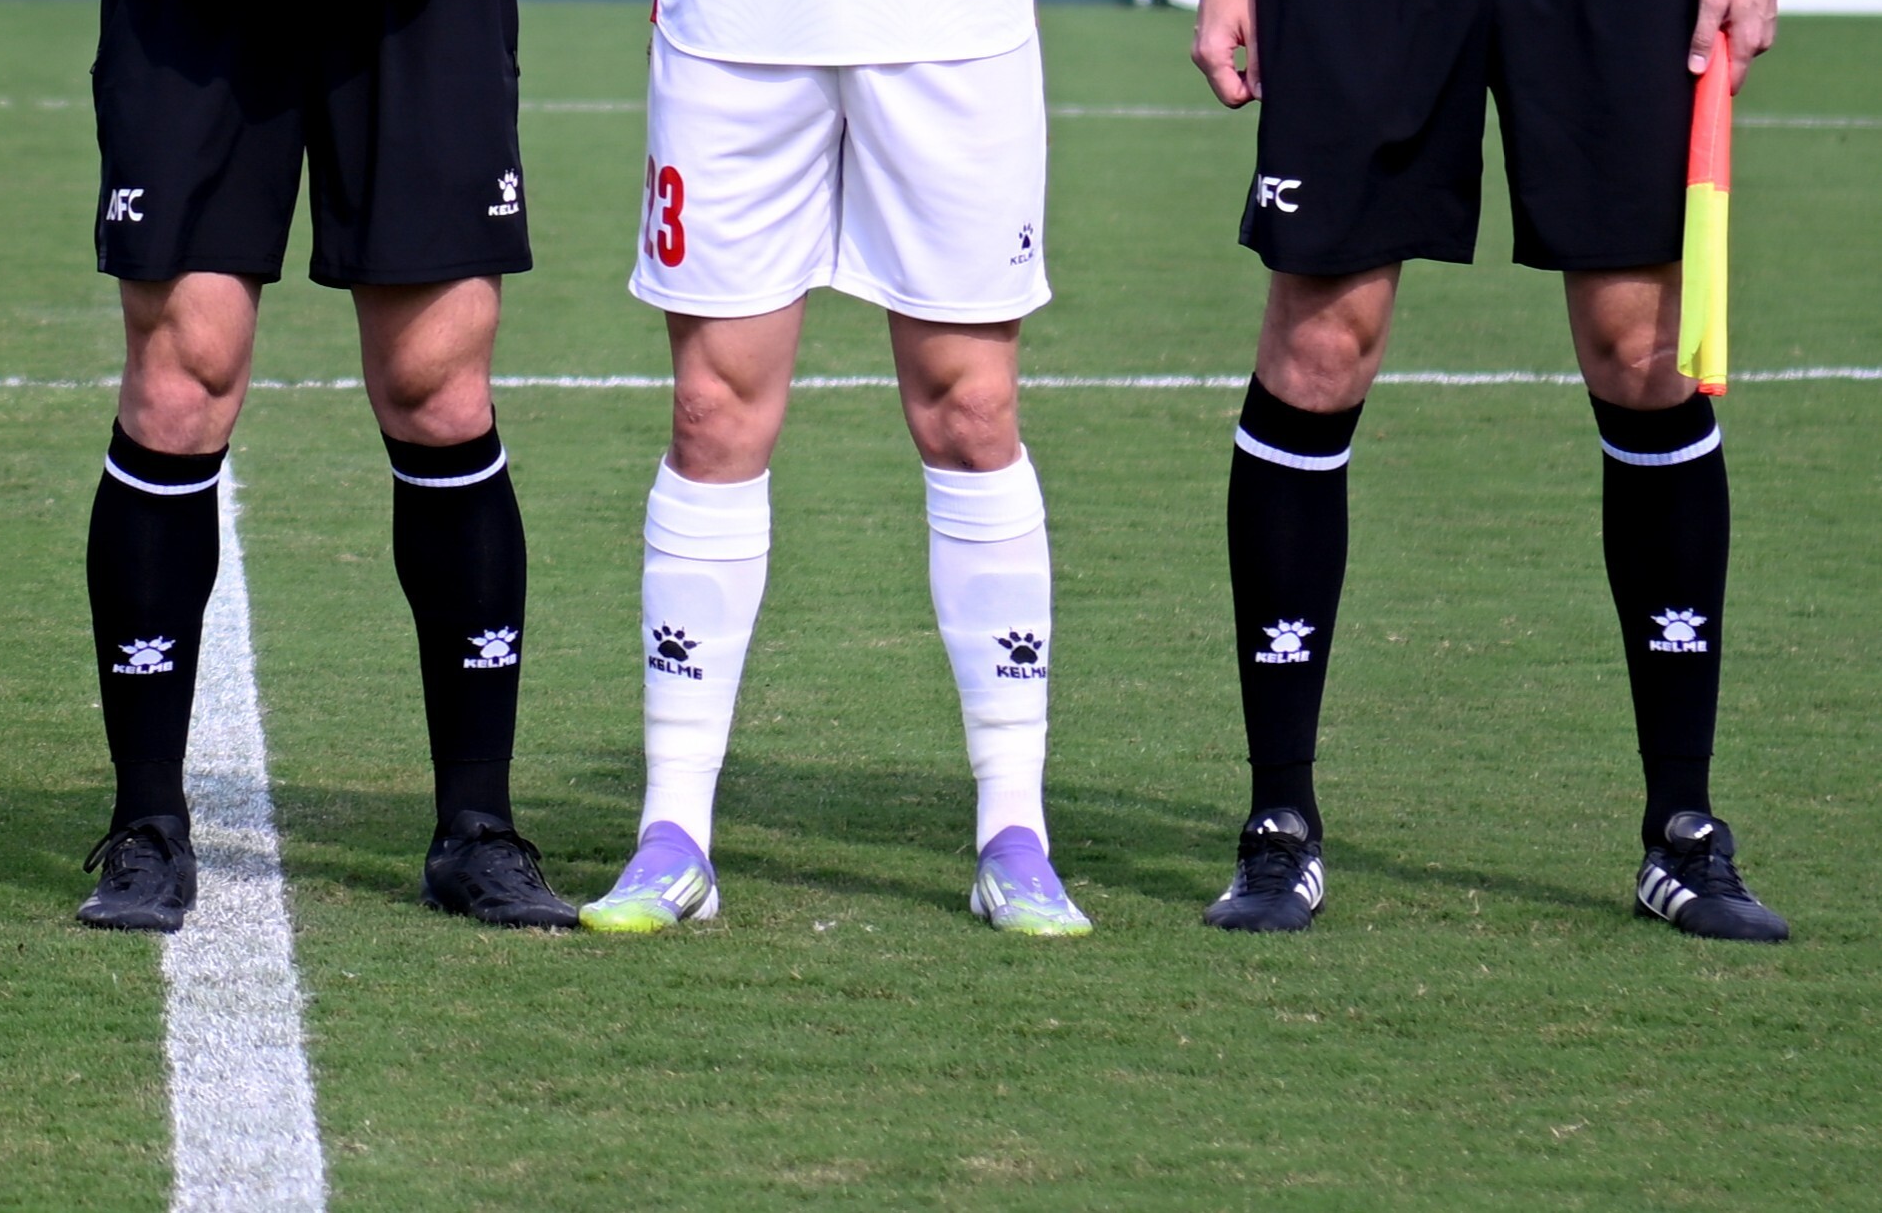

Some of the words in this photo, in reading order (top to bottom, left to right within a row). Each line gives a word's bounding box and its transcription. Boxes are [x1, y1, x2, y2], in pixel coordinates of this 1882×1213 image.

[106, 188, 144, 221] AFC
[644, 154, 685, 268] 23
[1649, 639, 1708, 653] KELME
[463, 653, 517, 668] KELME
[1255, 650, 1310, 664] KELME
[112, 661, 174, 674] KELME
[648, 655, 703, 681] KELME
